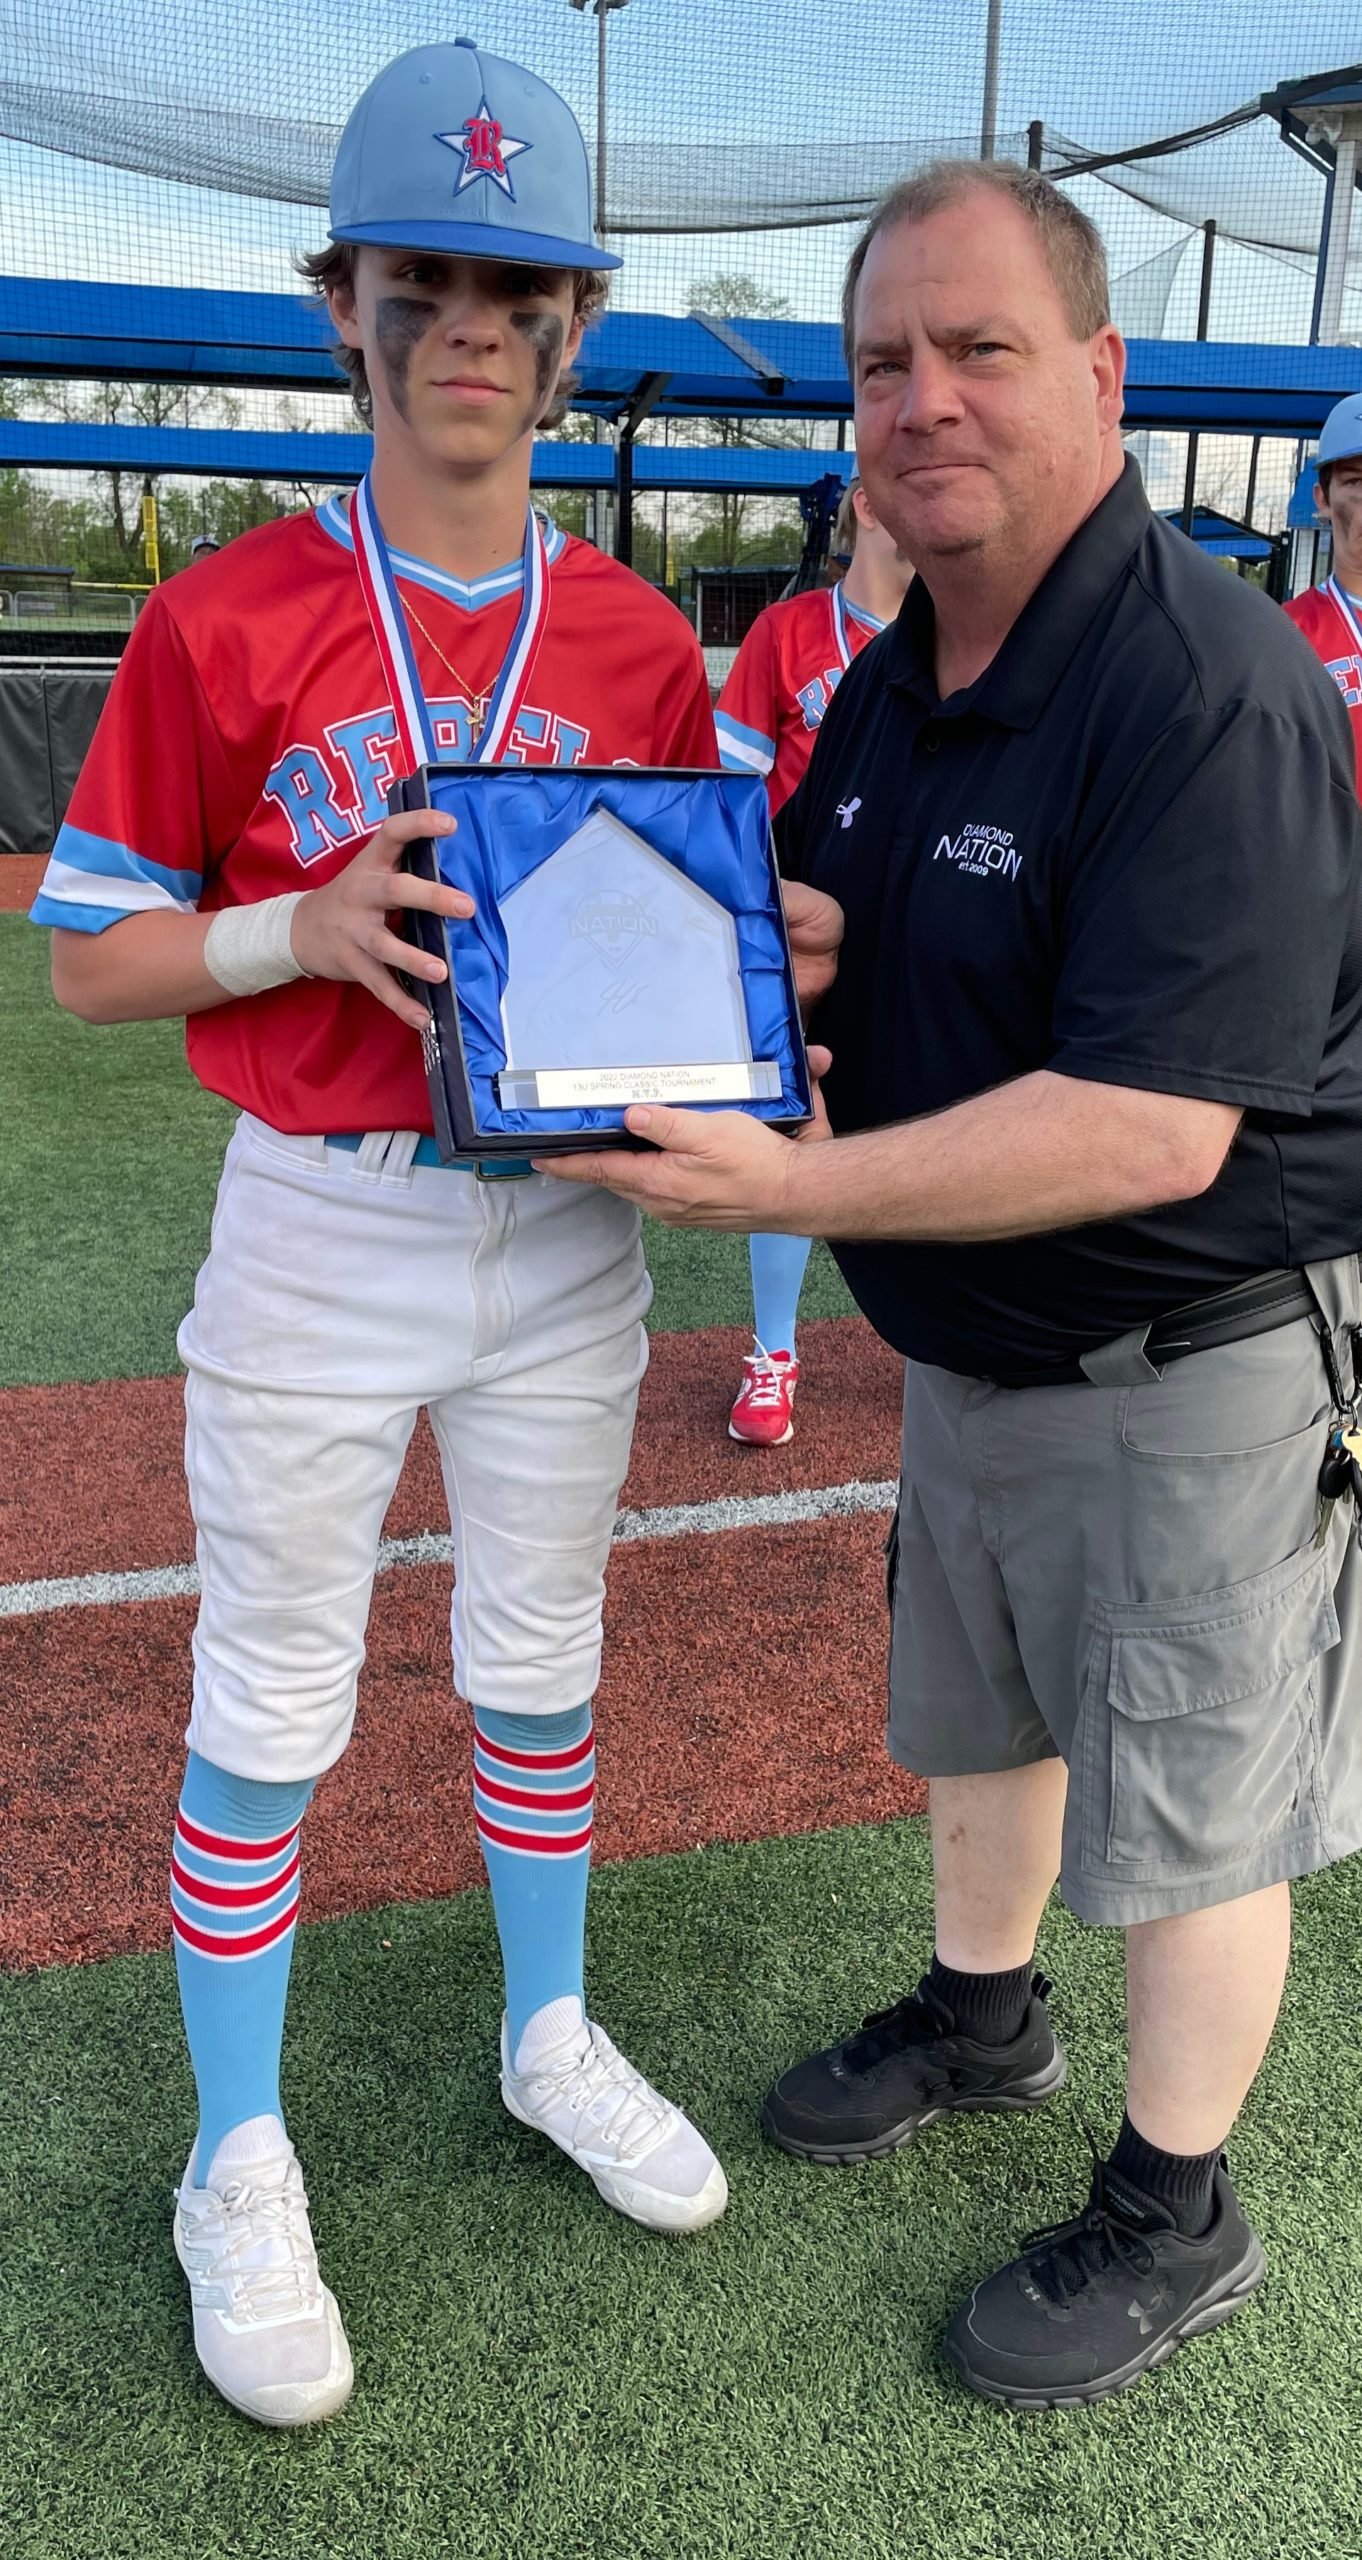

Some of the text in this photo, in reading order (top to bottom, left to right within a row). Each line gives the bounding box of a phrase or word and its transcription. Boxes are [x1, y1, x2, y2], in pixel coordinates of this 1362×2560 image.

[463, 118, 507, 178] R
[262, 695, 641, 869] REB
[962, 823, 1014, 846] DIAMOND
[933, 834, 1023, 882] NATION
[571, 915, 658, 936] NATION
[590, 1081, 622, 1090] SPRING
[624, 1079, 658, 1089] CLASSIC
[661, 1076, 717, 1087] TOURNAMENT
[599, 1070, 690, 1081] 2022 DIAMOND NATION
